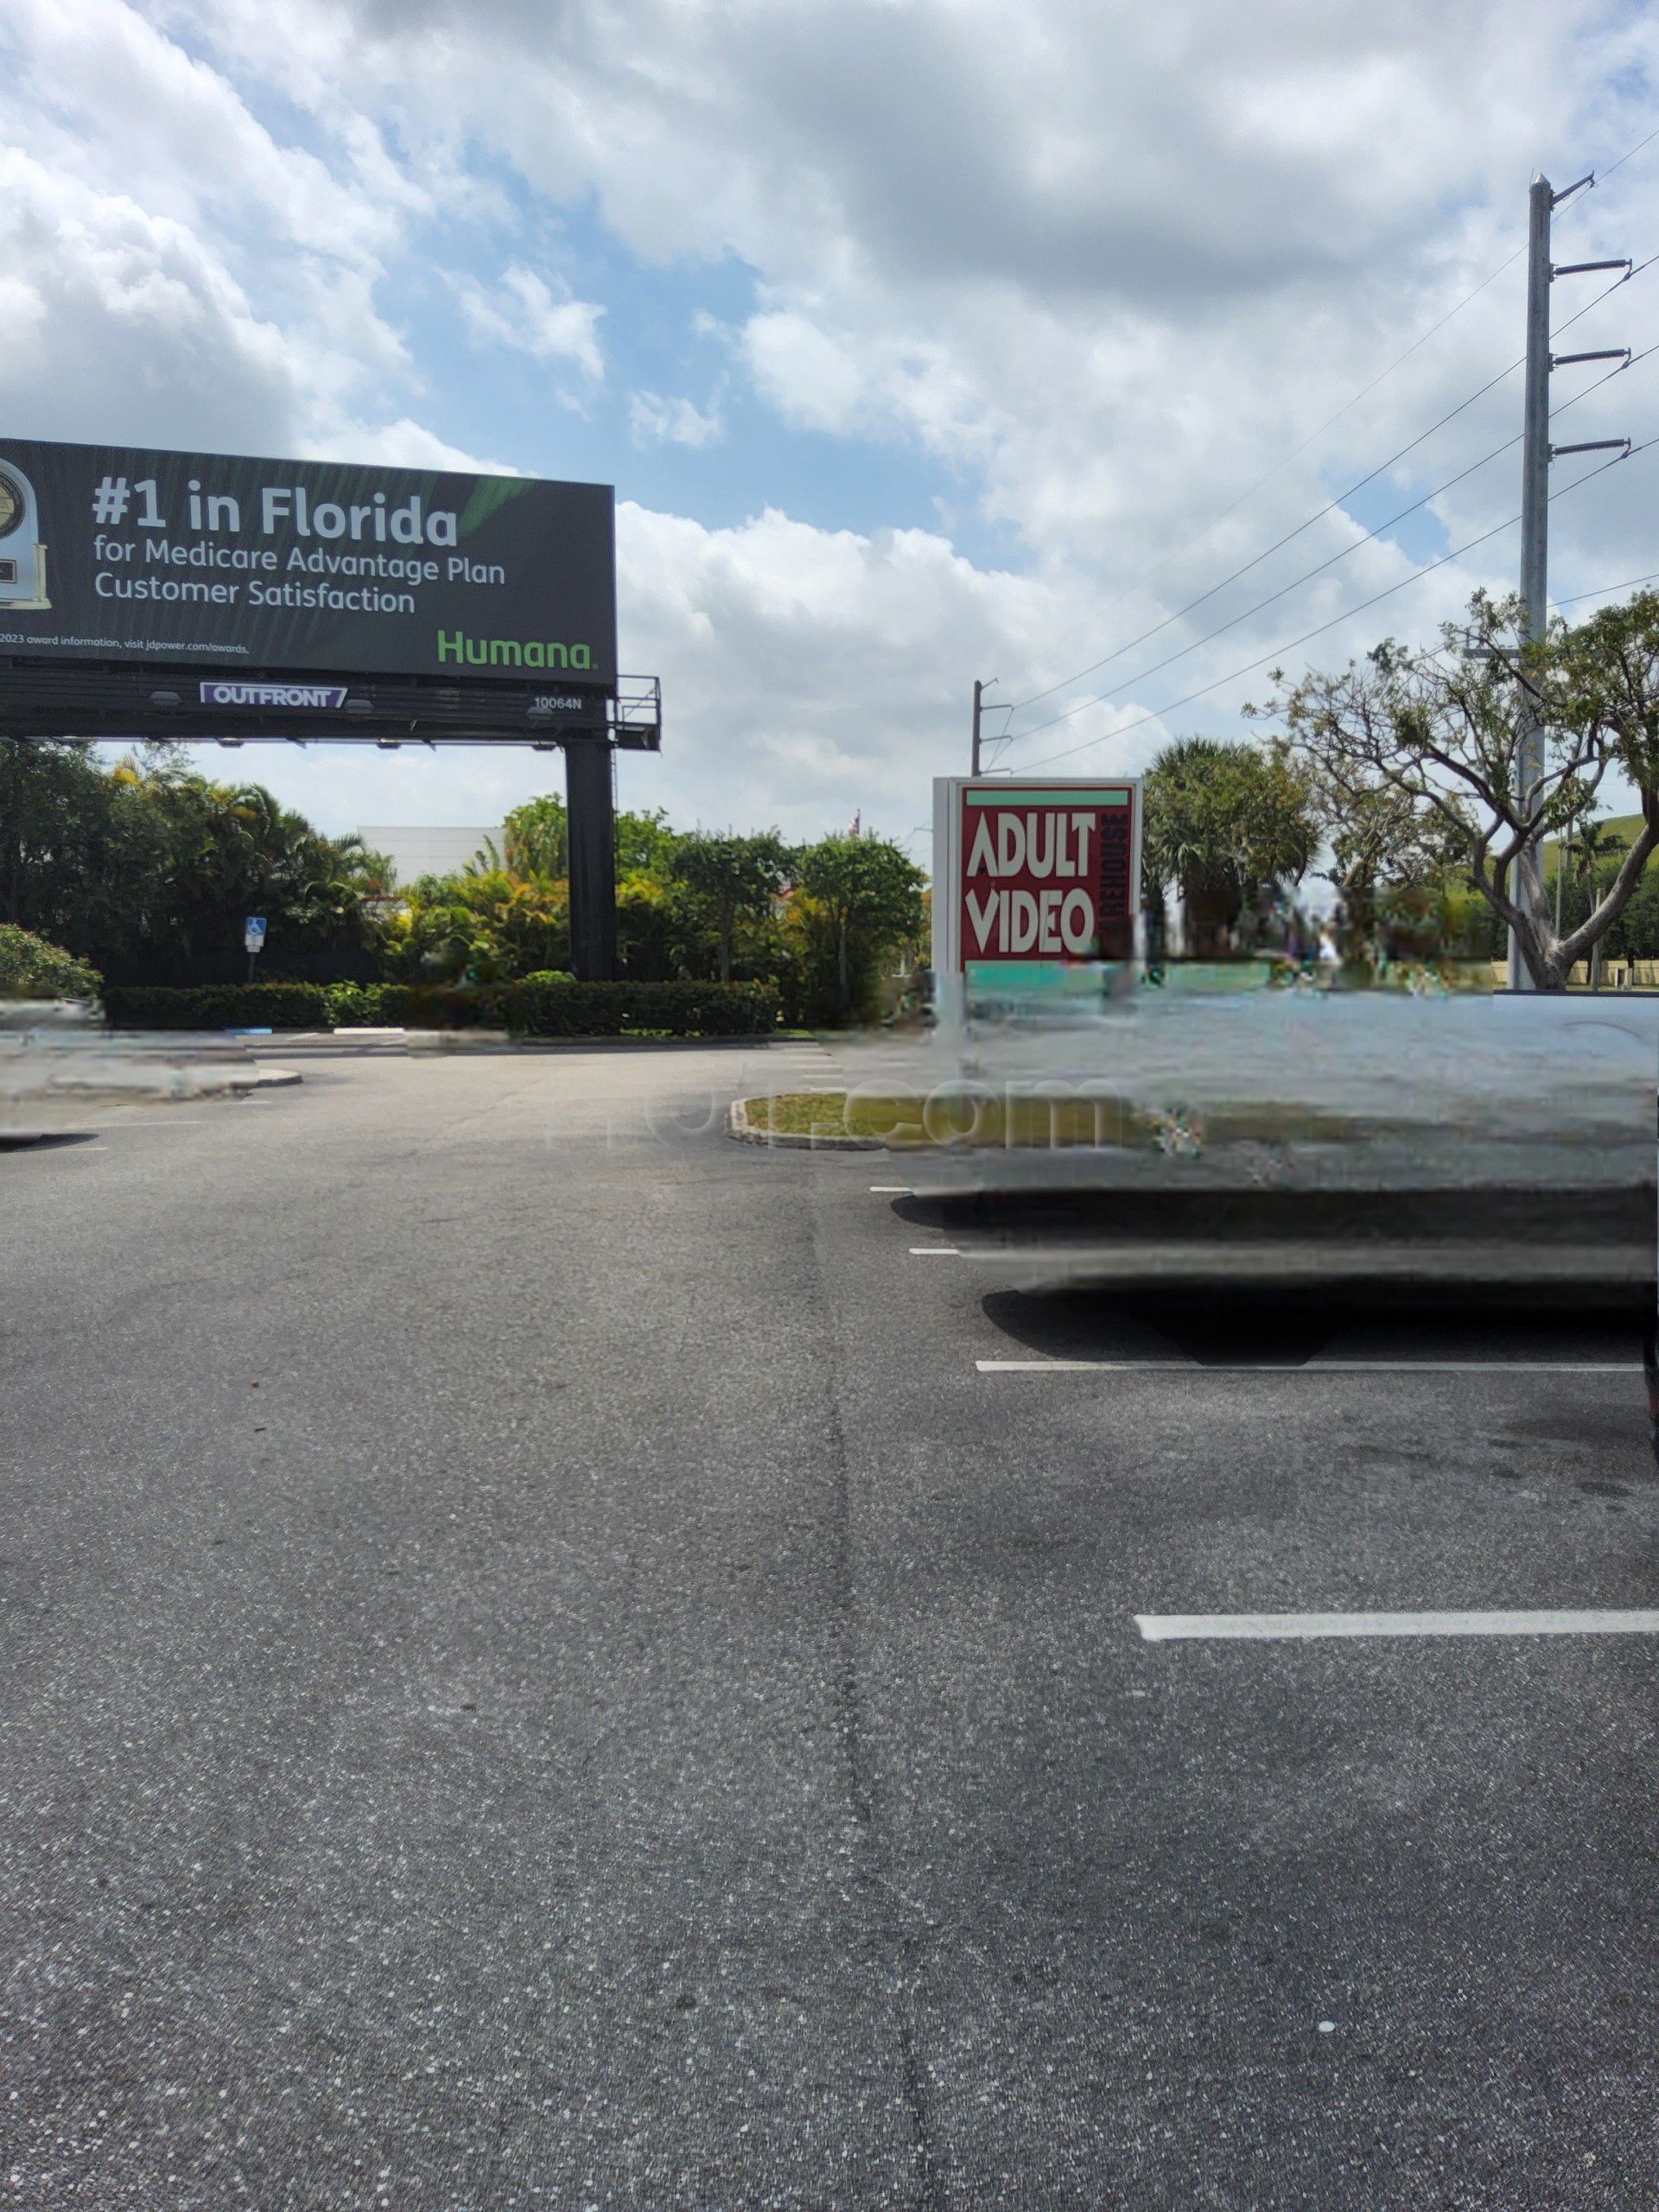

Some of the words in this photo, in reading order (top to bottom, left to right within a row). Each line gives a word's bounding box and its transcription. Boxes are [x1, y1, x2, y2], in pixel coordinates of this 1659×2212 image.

[92, 476, 167, 528] #1
[188, 480, 240, 532] in
[261, 486, 457, 547] Florida
[93, 534, 137, 562] for
[145, 538, 278, 570] Medicare
[286, 547, 440, 587] Advantage
[448, 556, 505, 585] Plan
[95, 572, 240, 604] Customer
[248, 580, 416, 613] Satisfaction
[0, 633, 24, 644] 2023
[26, 636, 59, 645] award
[60, 636, 122, 649] information,
[124, 639, 144, 650] visit
[213, 686, 332, 707] OUTFRONT
[534, 696, 582, 710] 10064N
[966, 810, 1096, 879] ADULT
[964, 887, 1096, 955] VIDEO
